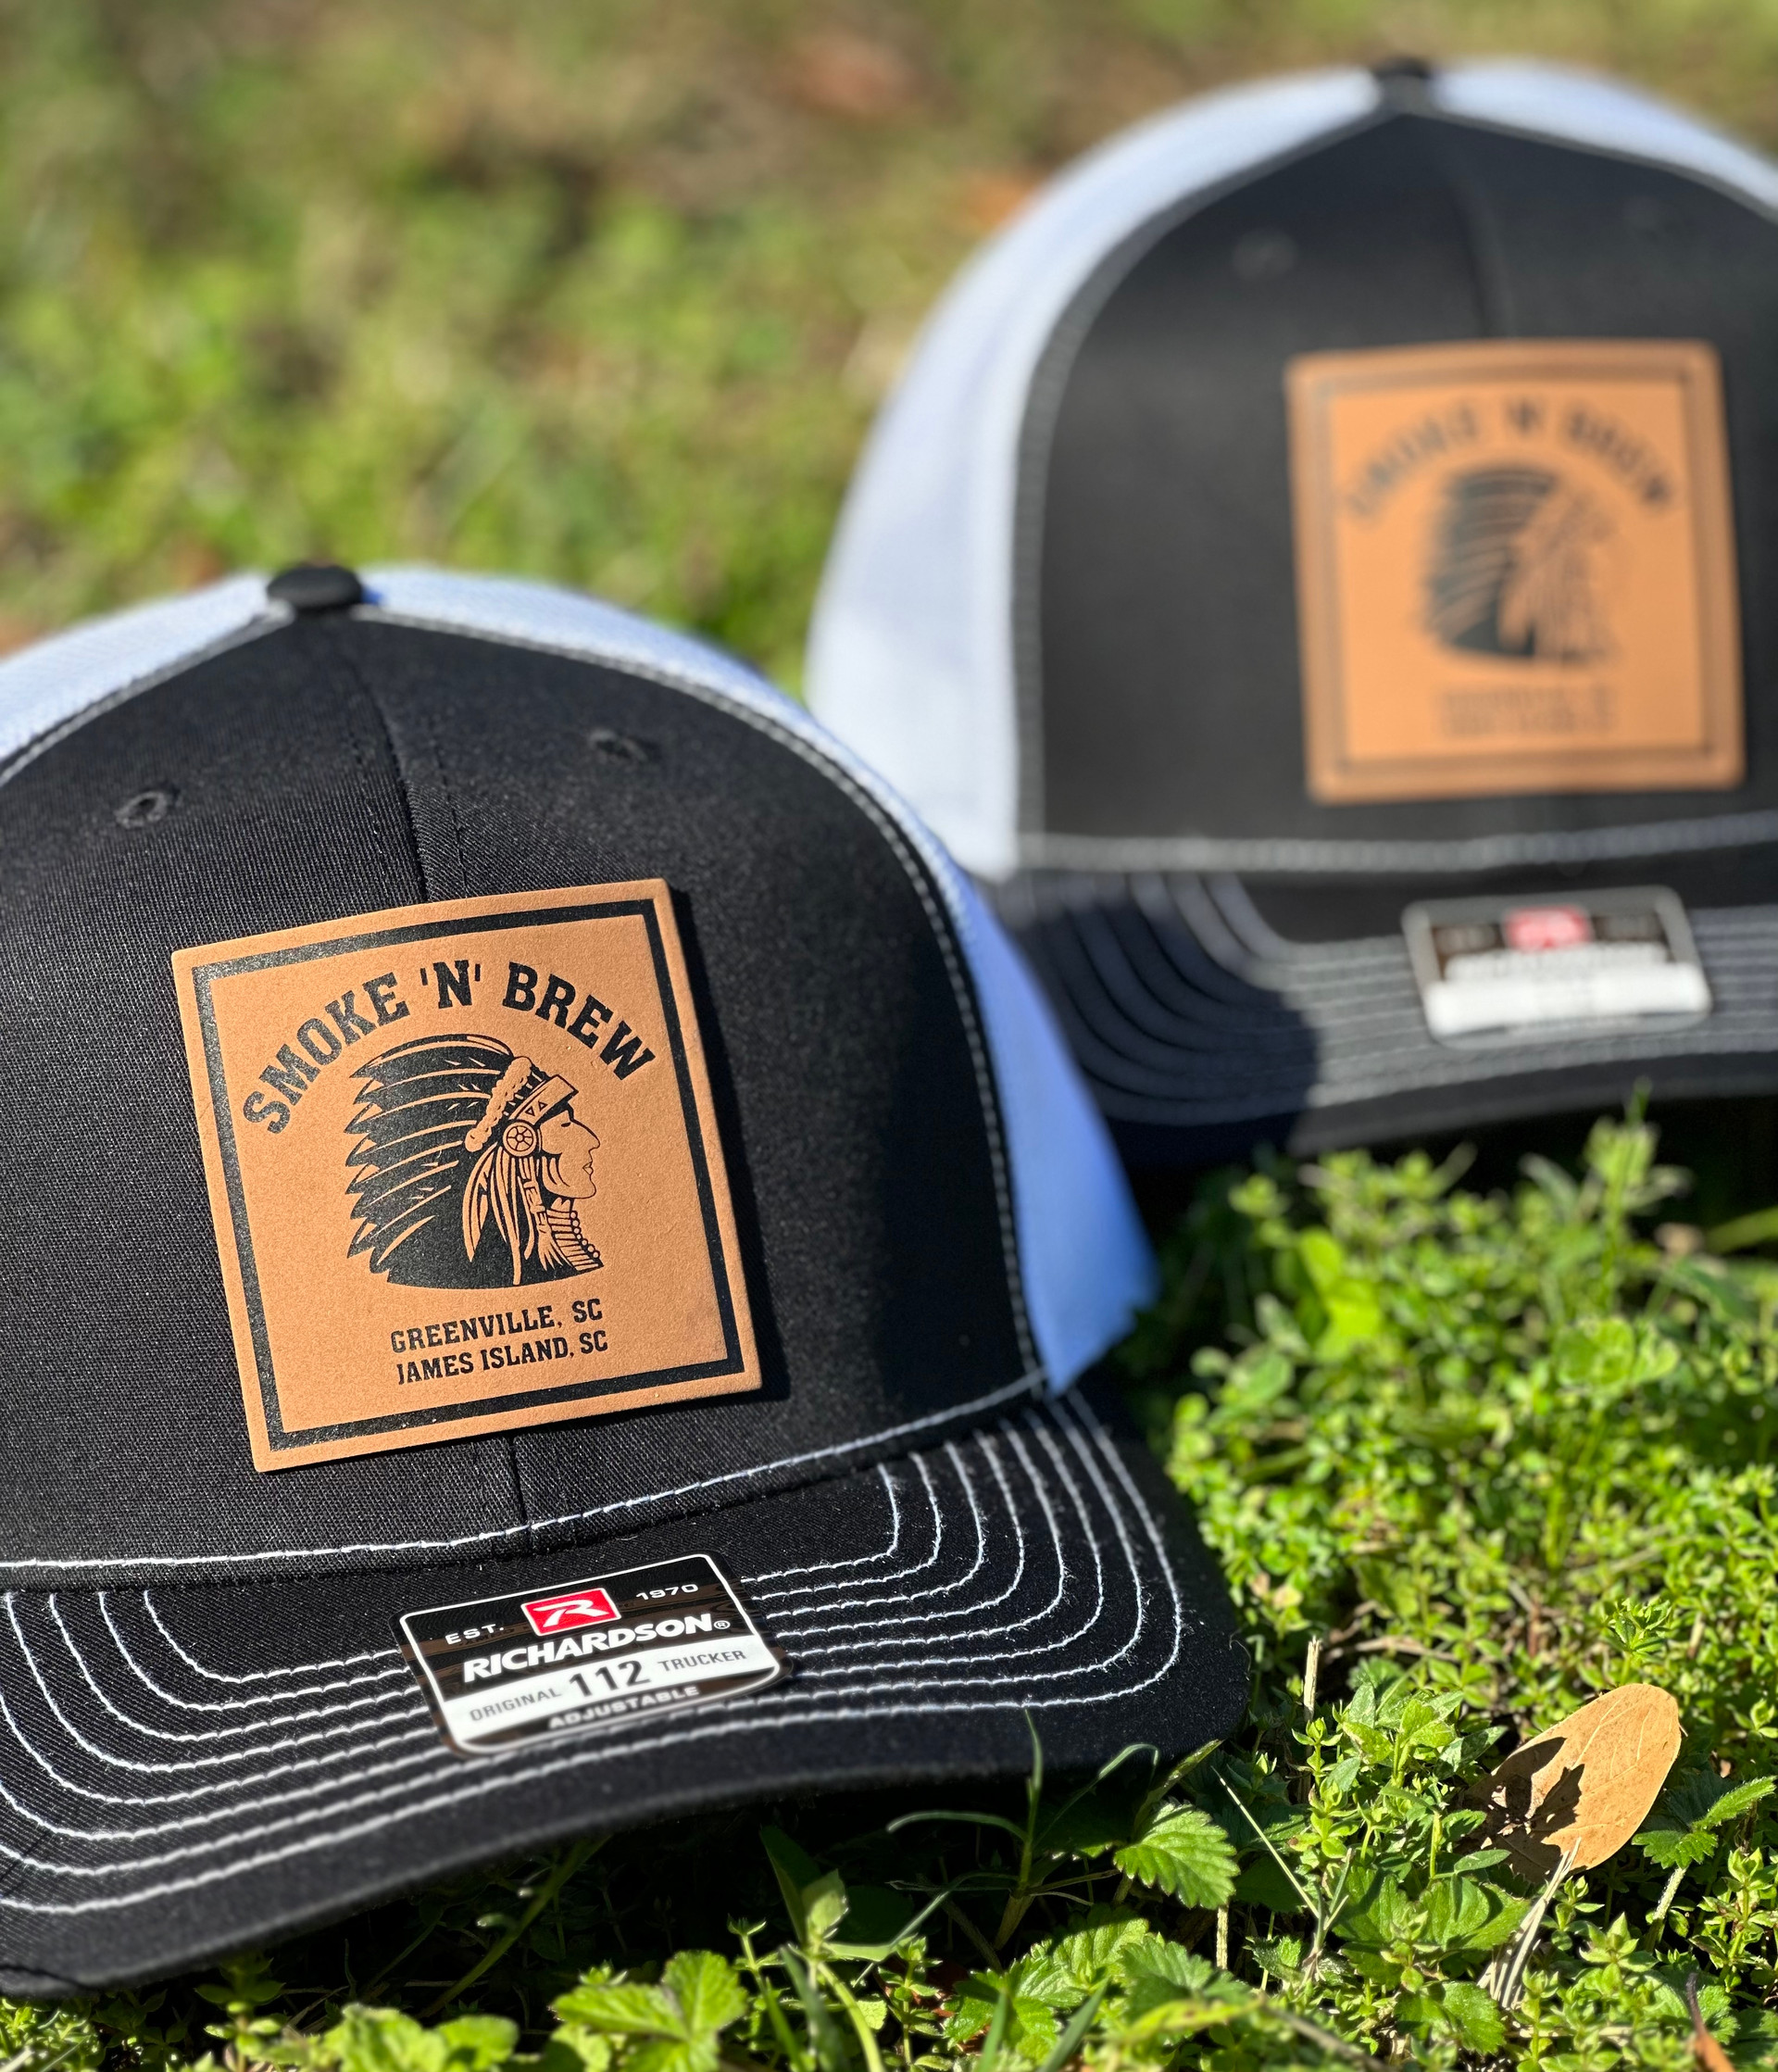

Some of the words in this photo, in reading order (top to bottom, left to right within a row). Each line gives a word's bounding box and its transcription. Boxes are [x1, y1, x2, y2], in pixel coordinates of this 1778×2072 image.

[244, 972, 410, 1134] SMOKE
[420, 960, 481, 1009] 'N'
[503, 961, 656, 1081] BREW
[391, 1305, 562, 1353] GREENVILLE,
[572, 1298, 603, 1324] SC
[396, 1352, 474, 1385] JAMES
[480, 1337, 574, 1370] ISLAND,
[579, 1330, 608, 1355] SC
[444, 1624, 504, 1645] EST.
[636, 1584, 699, 1601] 1970
[469, 1688, 561, 1721] ORIGINAL
[569, 1659, 652, 1698] 112
[657, 1650, 746, 1673] TRUCKER
[546, 1686, 701, 1729] ADJUSTABLE
